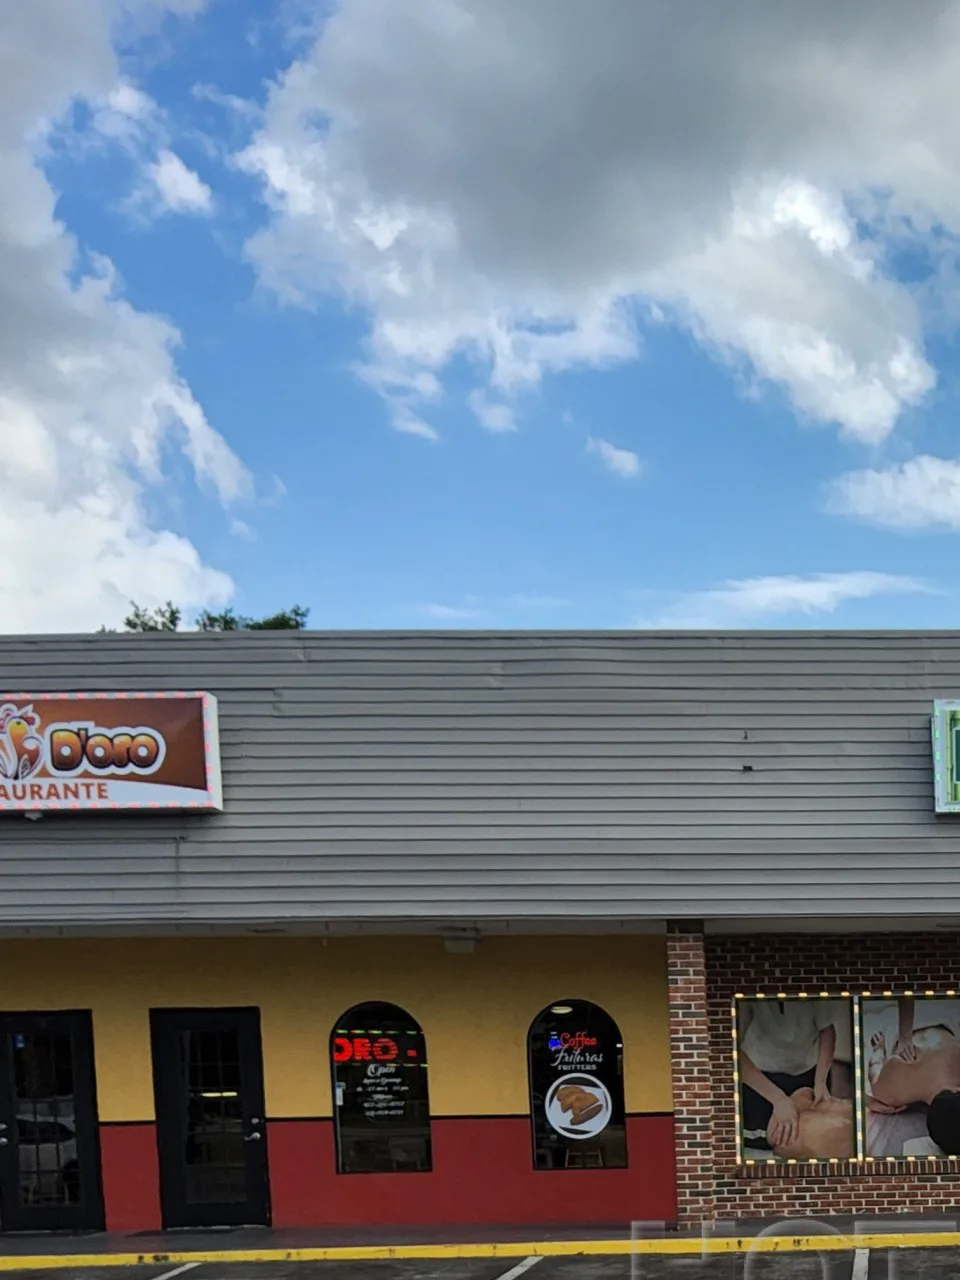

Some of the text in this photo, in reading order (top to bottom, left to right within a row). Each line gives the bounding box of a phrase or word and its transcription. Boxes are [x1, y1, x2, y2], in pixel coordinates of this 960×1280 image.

[49, 727, 160, 772] D'oro
[560, 1032, 598, 1050] Coffee
[557, 1063, 598, 1071] FRITTERS
